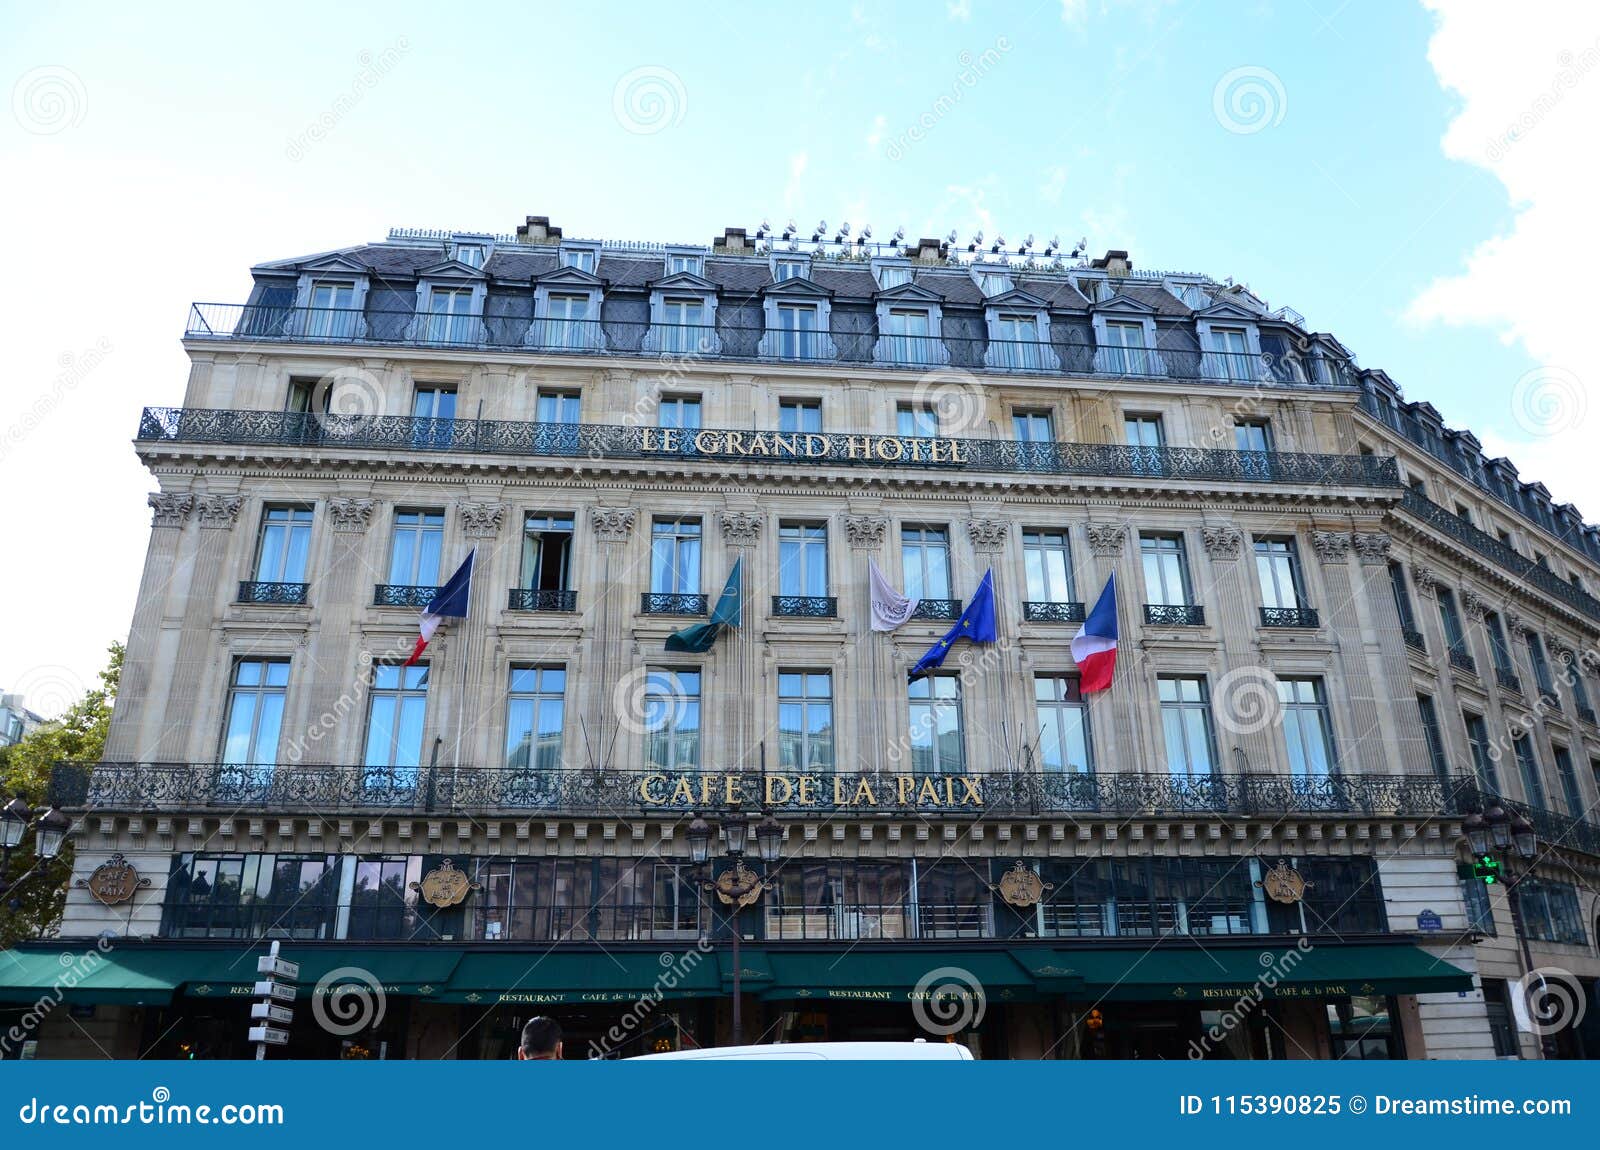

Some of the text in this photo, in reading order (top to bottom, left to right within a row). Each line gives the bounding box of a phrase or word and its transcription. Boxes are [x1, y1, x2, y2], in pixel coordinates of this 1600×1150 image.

[641, 428, 968, 463] LE GRAND HOTEL
[640, 774, 985, 805] CAFE DE LA PAIX
[499, 993, 565, 1002] RESTAURANT
[628, 992, 636, 1000] la
[829, 990, 892, 999] RESTAURANT
[936, 992, 946, 1000] de
[950, 991, 958, 1000] la
[962, 991, 984, 1000] PAIX
[1203, 988, 1260, 997] RESTAURANT
[1301, 987, 1311, 996] de
[1326, 986, 1347, 995] PAIX
